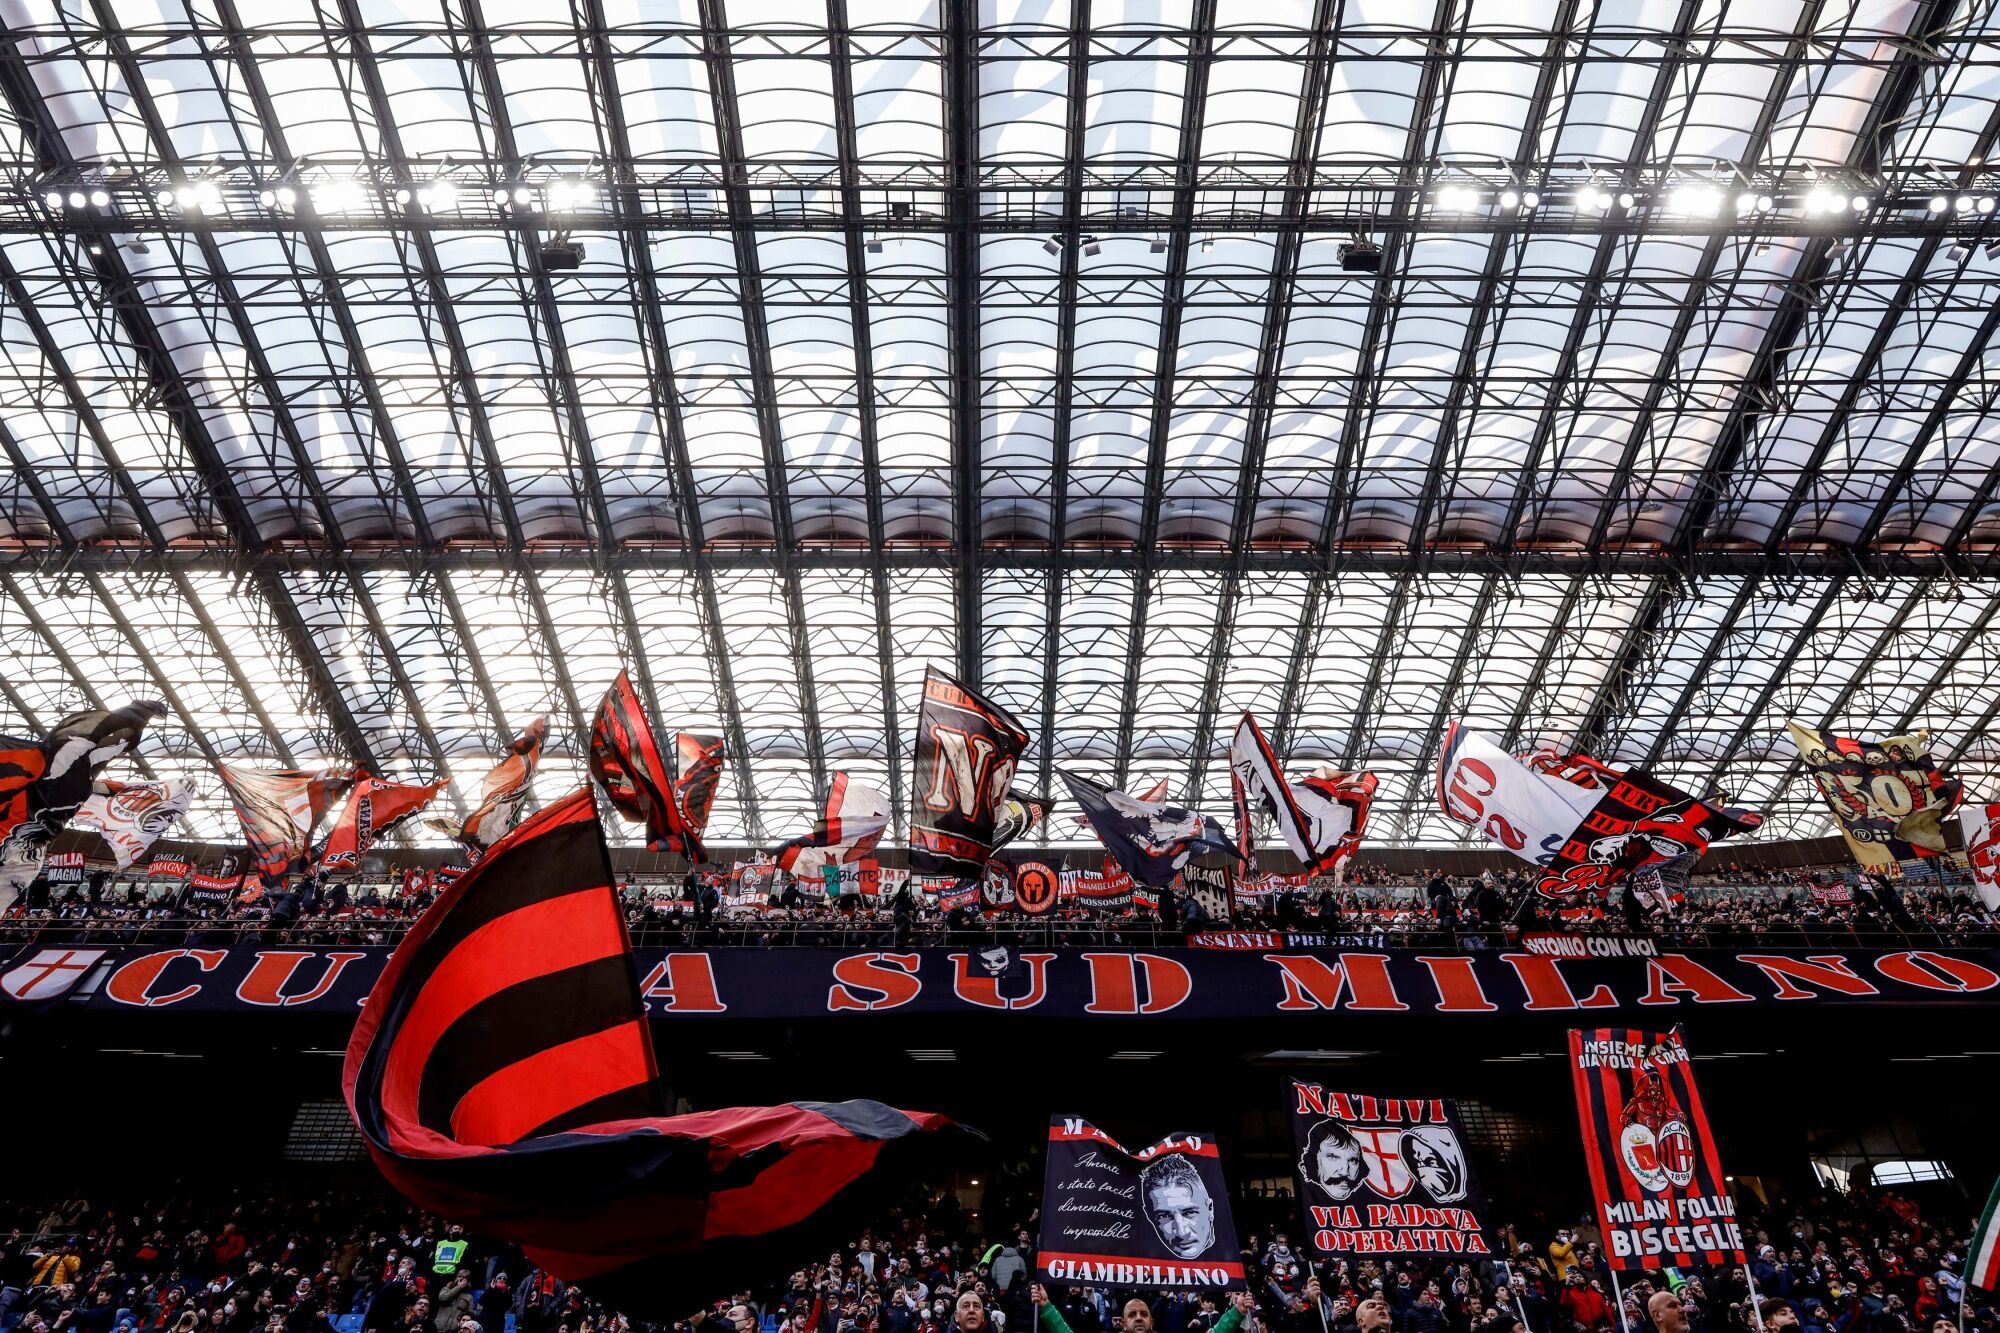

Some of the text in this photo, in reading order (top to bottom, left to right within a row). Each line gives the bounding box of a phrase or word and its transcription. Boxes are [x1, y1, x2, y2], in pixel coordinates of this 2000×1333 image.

[1079, 876, 1129, 891] GIAMBELLINO
[1184, 863, 1226, 889] MILANO
[193, 891, 227, 900] MISANO
[1080, 895, 1131, 907] ROSSONERO
[1192, 932, 1276, 948] ASSENTI
[1586, 936, 1624, 957] CON
[1624, 938, 1659, 956] NOI
[105, 948, 2000, 1014] CUA SUD MILANO
[1578, 1053, 1635, 1069] DIAVOLO
[1654, 1047, 1690, 1066] CORPO
[1584, 1040, 1646, 1058] INSIEME
[1293, 1082, 1448, 1122] NATIVI
[1063, 1118, 1202, 1158] MAOLO
[1662, 1123, 1688, 1135] ACM
[1074, 1151, 1121, 1175] Amarti
[1670, 1172, 1690, 1181] 1899
[1068, 1178, 1097, 1190] stato
[1098, 1182, 1135, 1200] facile
[1058, 1197, 1135, 1219] dimenticarti
[1310, 1203, 1482, 1230] VIA PADOVA
[1603, 1195, 1737, 1224] MILAN FOLLIA
[1063, 1222, 1130, 1240] impossibile
[1314, 1229, 1491, 1253] OPERATIVA
[1610, 1223, 1745, 1257] BISCEGLIE
[1047, 1258, 1230, 1286] GIAMBELLINO
